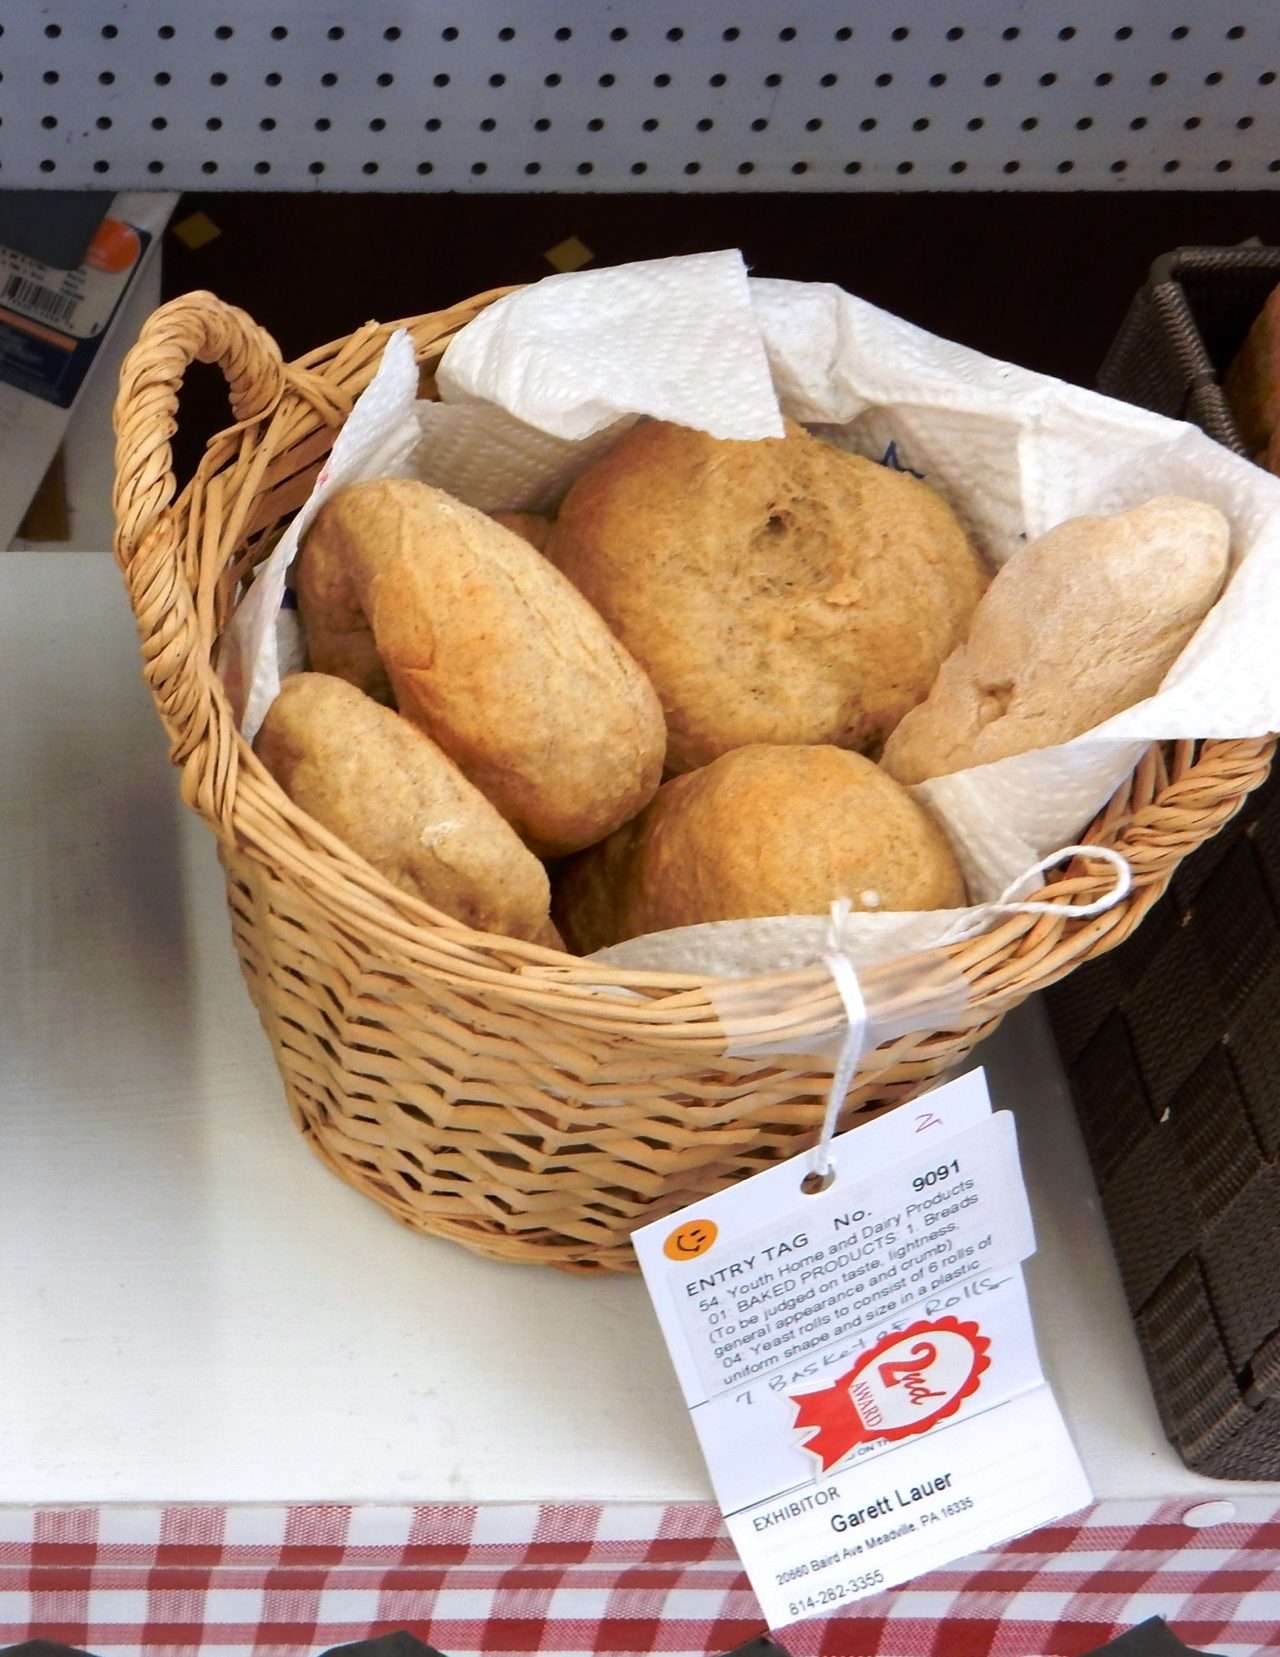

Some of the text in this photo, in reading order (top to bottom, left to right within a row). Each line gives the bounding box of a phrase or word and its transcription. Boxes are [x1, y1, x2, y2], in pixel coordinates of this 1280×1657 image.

[686, 1159, 961, 1297] ENTRY TAG No. 9091
[726, 1273, 774, 1299] Youth
[778, 1251, 825, 1277] Home
[829, 1232, 857, 1254] and
[862, 1214, 901, 1239] Dairy
[906, 1179, 975, 1217] Products
[737, 1279, 796, 1312] BAKED
[924, 1193, 978, 1226] Breads
[709, 1326, 735, 1343] (To
[740, 1315, 759, 1328] be
[764, 1288, 815, 1321] judged
[819, 1279, 839, 1292] on
[714, 1239, 953, 1358] general appearance and crumb)
[724, 1260, 980, 1385] uniform shape and size in a plastic
[750, 1331, 796, 1354] Yeast
[799, 1315, 831, 1335] rolls
[835, 1306, 849, 1319] to
[853, 1281, 908, 1310] consist
[910, 1267, 925, 1283] of
[928, 1261, 938, 1274] 6
[942, 1245, 975, 1267] rolls
[978, 1234, 993, 1250] of
[851, 1380, 883, 1427] AWARD
[878, 1340, 947, 1405] 2nd
[752, 1486, 841, 1532] EXHIBITOR
[830, 1472, 952, 1533] Garett Lauer
[811, 1552, 841, 1572] Baird
[842, 1544, 863, 1559] Ave
[920, 1512, 940, 1527] PA
[788, 1569, 885, 1616] 814-282-3355
